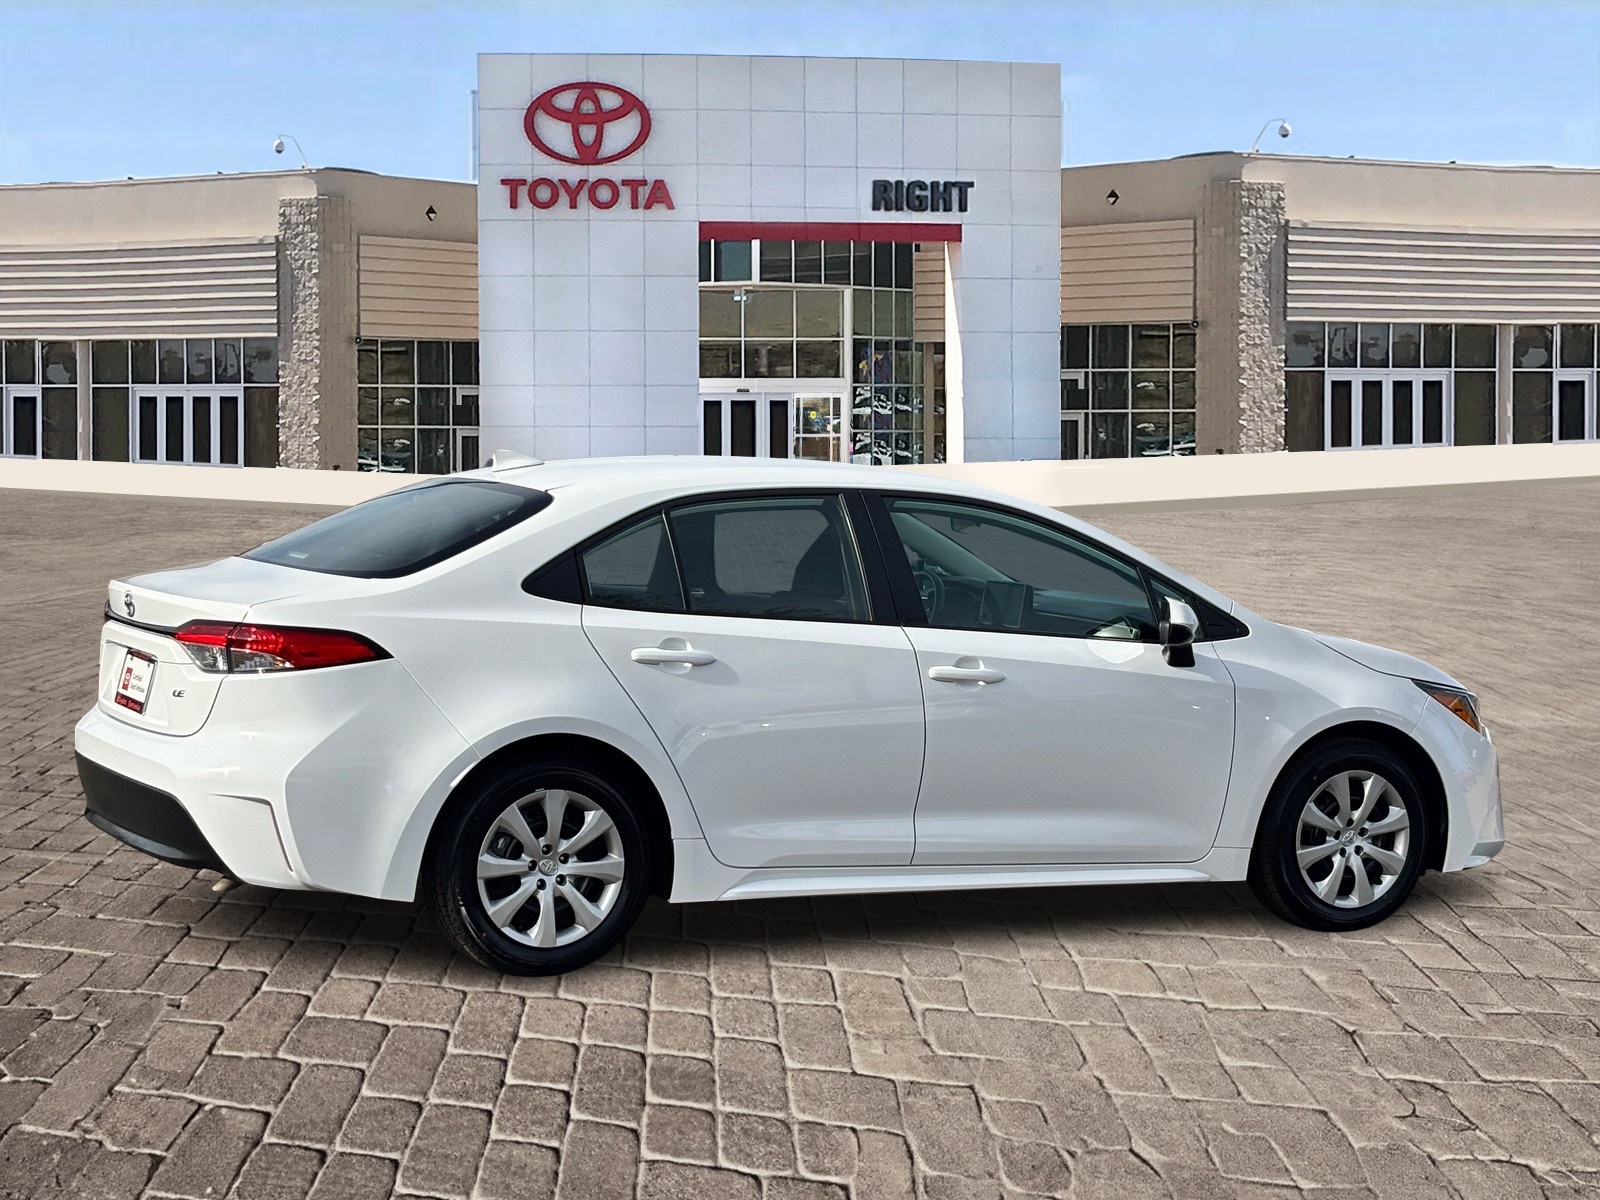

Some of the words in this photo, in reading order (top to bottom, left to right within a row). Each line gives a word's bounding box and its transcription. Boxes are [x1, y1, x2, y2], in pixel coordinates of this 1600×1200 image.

[500, 178, 676, 210] TOYOTA
[872, 179, 976, 213] RIGHT
[172, 689, 186, 698] LE
